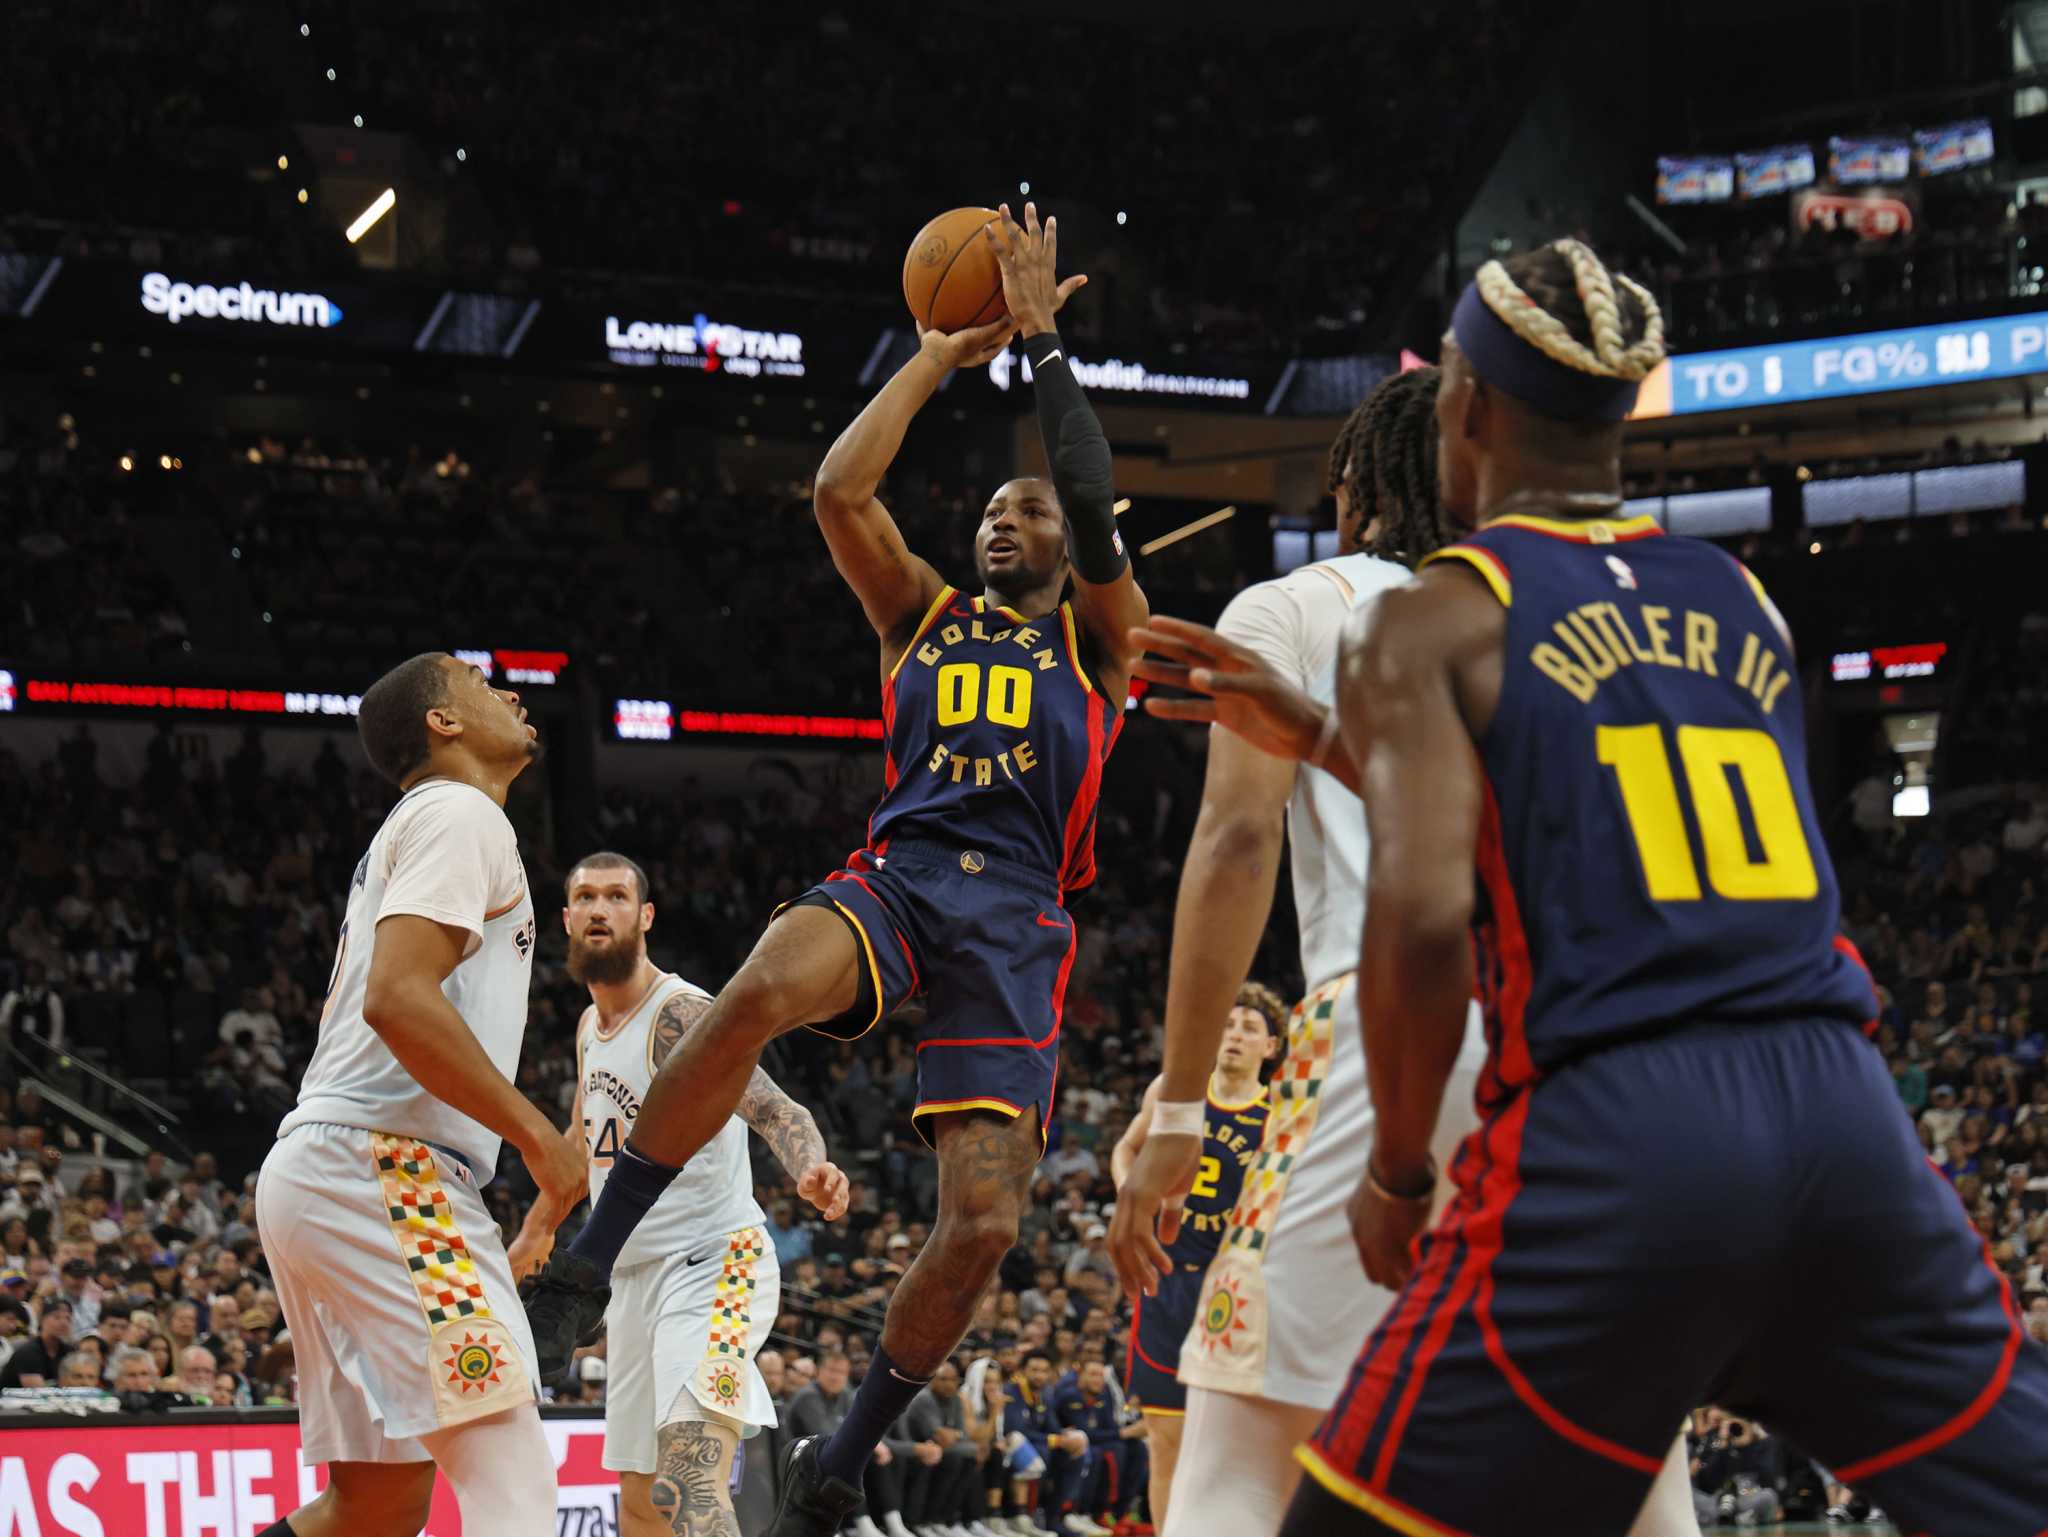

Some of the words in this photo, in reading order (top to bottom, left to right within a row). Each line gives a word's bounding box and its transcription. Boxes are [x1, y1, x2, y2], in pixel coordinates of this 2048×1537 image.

[142, 272, 329, 327] Spectrum
[606, 316, 697, 354] LONE
[2011, 325, 2048, 366] P
[1684, 361, 1749, 400] TO
[1813, 341, 1928, 387] FG%
[916, 620, 1058, 671] GOLDEN
[1530, 601, 1718, 703] BUTLER
[1736, 633, 1791, 714] III
[937, 663, 1033, 729] 00
[928, 740, 1038, 786] STATE
[1595, 724, 1818, 900] 10
[1203, 1121, 1254, 1166] LDEN
[1191, 1155, 1221, 1198] 2
[126, 1449, 276, 1537] THE
